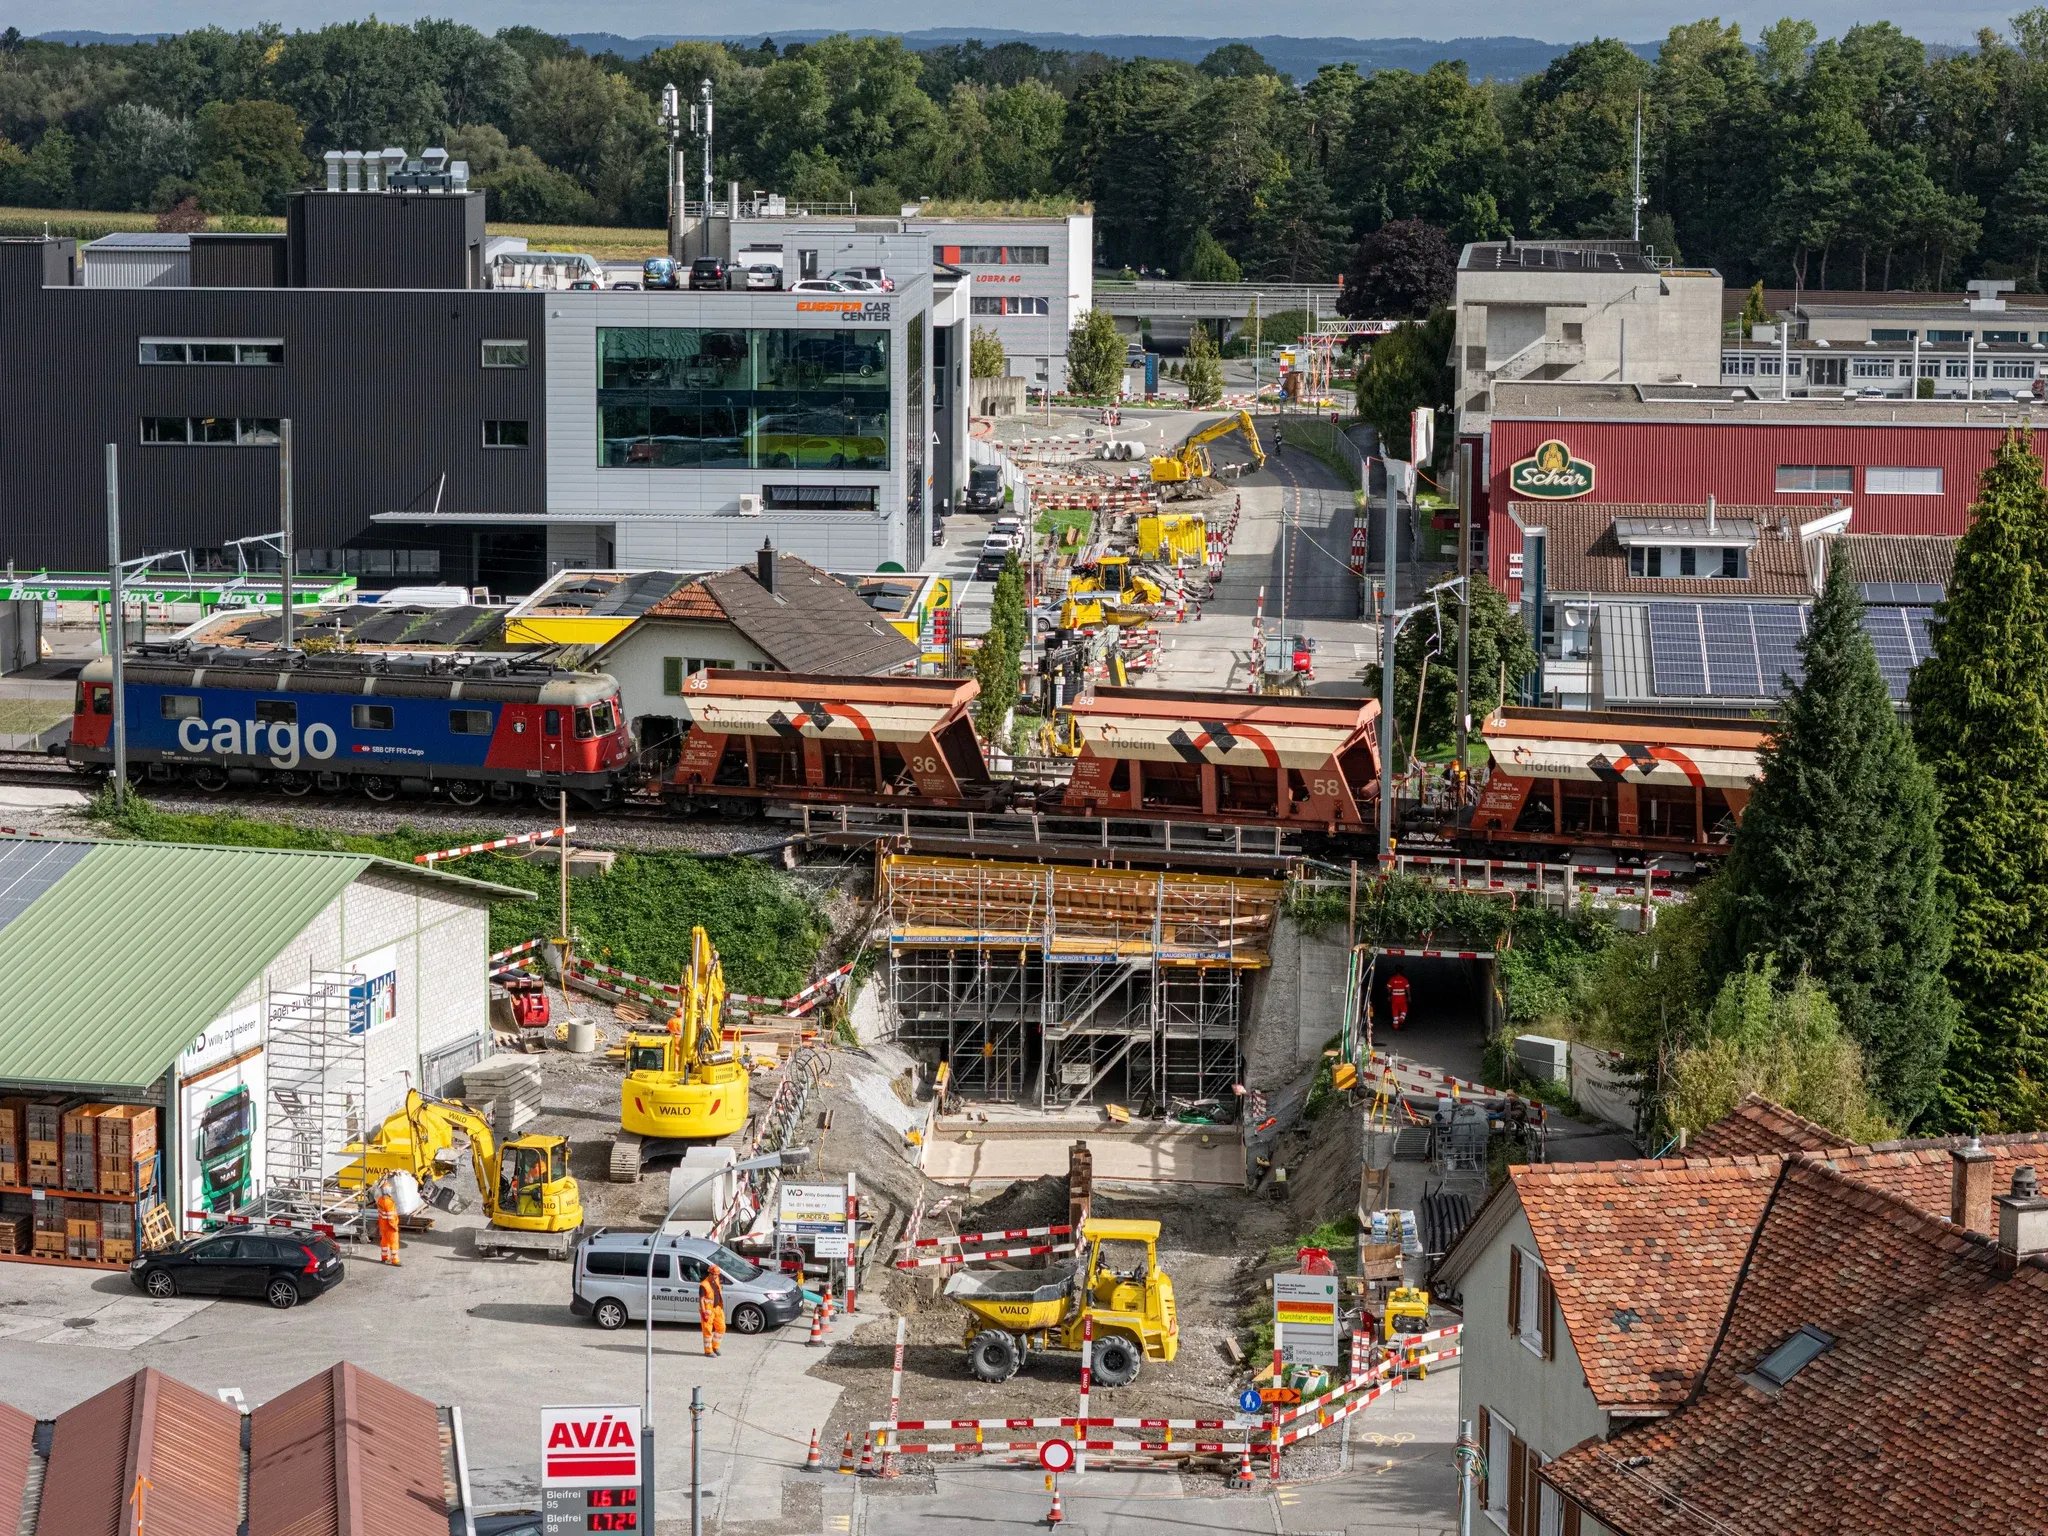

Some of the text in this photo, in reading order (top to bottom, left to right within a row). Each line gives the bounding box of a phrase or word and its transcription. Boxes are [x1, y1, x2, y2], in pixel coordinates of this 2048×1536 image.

[797, 302, 890, 311] EUGSTER CAR
[842, 312, 890, 321] CENTER
[1517, 467, 1587, 486] Schär
[9, 588, 44, 601] Box
[121, 590, 150, 602] Box
[217, 592, 253, 604] Box
[690, 679, 708, 690] 36
[1079, 696, 1094, 706] 58
[713, 717, 755, 729] Holcim
[1491, 719, 1507, 728] 46
[178, 716, 337, 769] cargo
[1111, 737, 1156, 750] Holcim
[408, 748, 424, 756] Cargo
[912, 756, 937, 773] 36
[1524, 760, 1571, 774] Holcim
[1313, 779, 1340, 796] 58
[208, 1034, 223, 1047] Willy
[225, 1021, 256, 1040] Dornbierer
[659, 1106, 691, 1115] WALO
[448, 1111, 467, 1123] WALO
[220, 1169, 236, 1183] MAN
[999, 1306, 1030, 1315] WALO
[895, 1345, 903, 1368] WALO
[890, 1400, 898, 1421] WALO
[547, 1490, 580, 1498] Bleifrei
[547, 1501, 558, 1509] 95
[547, 1514, 581, 1523] Bleifrei
[547, 1524, 559, 1532] 98
